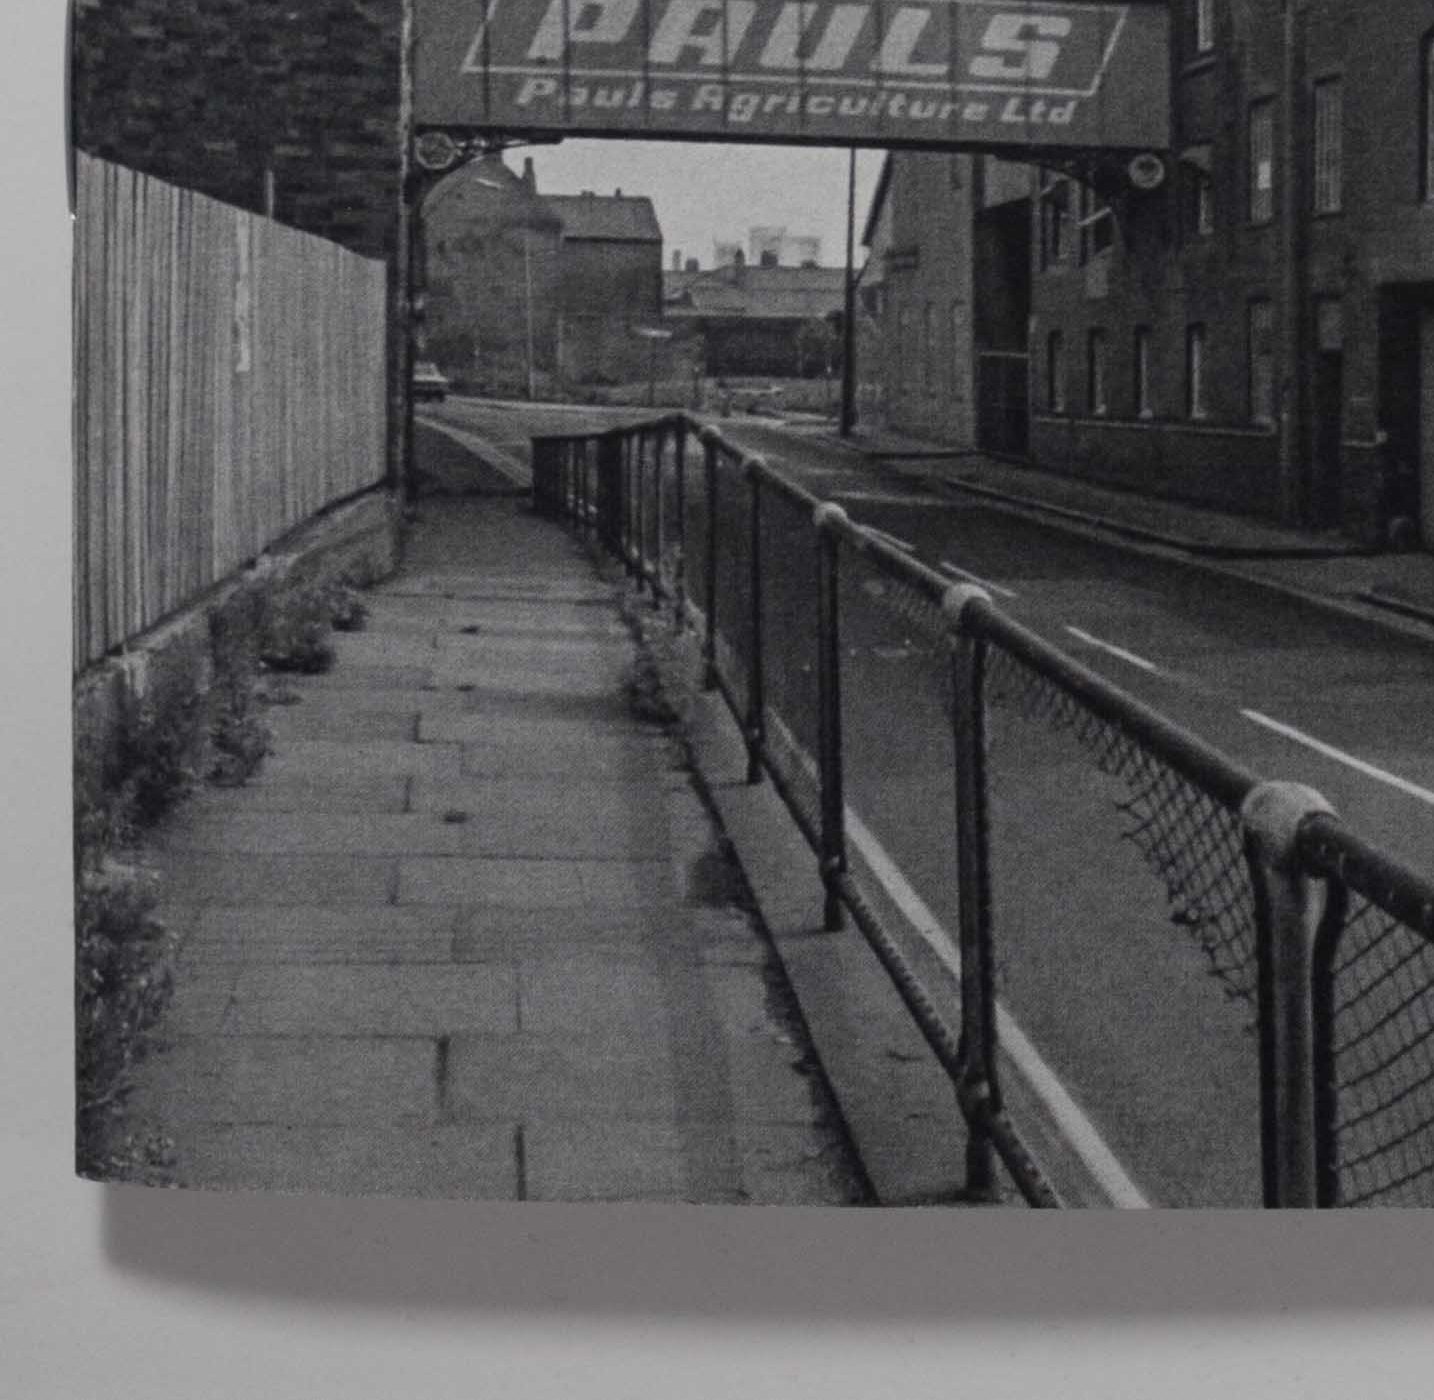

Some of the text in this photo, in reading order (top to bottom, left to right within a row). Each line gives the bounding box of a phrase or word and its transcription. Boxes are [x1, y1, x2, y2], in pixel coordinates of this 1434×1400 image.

[517, 77, 1077, 125] Pauls Agriculture Ltd
